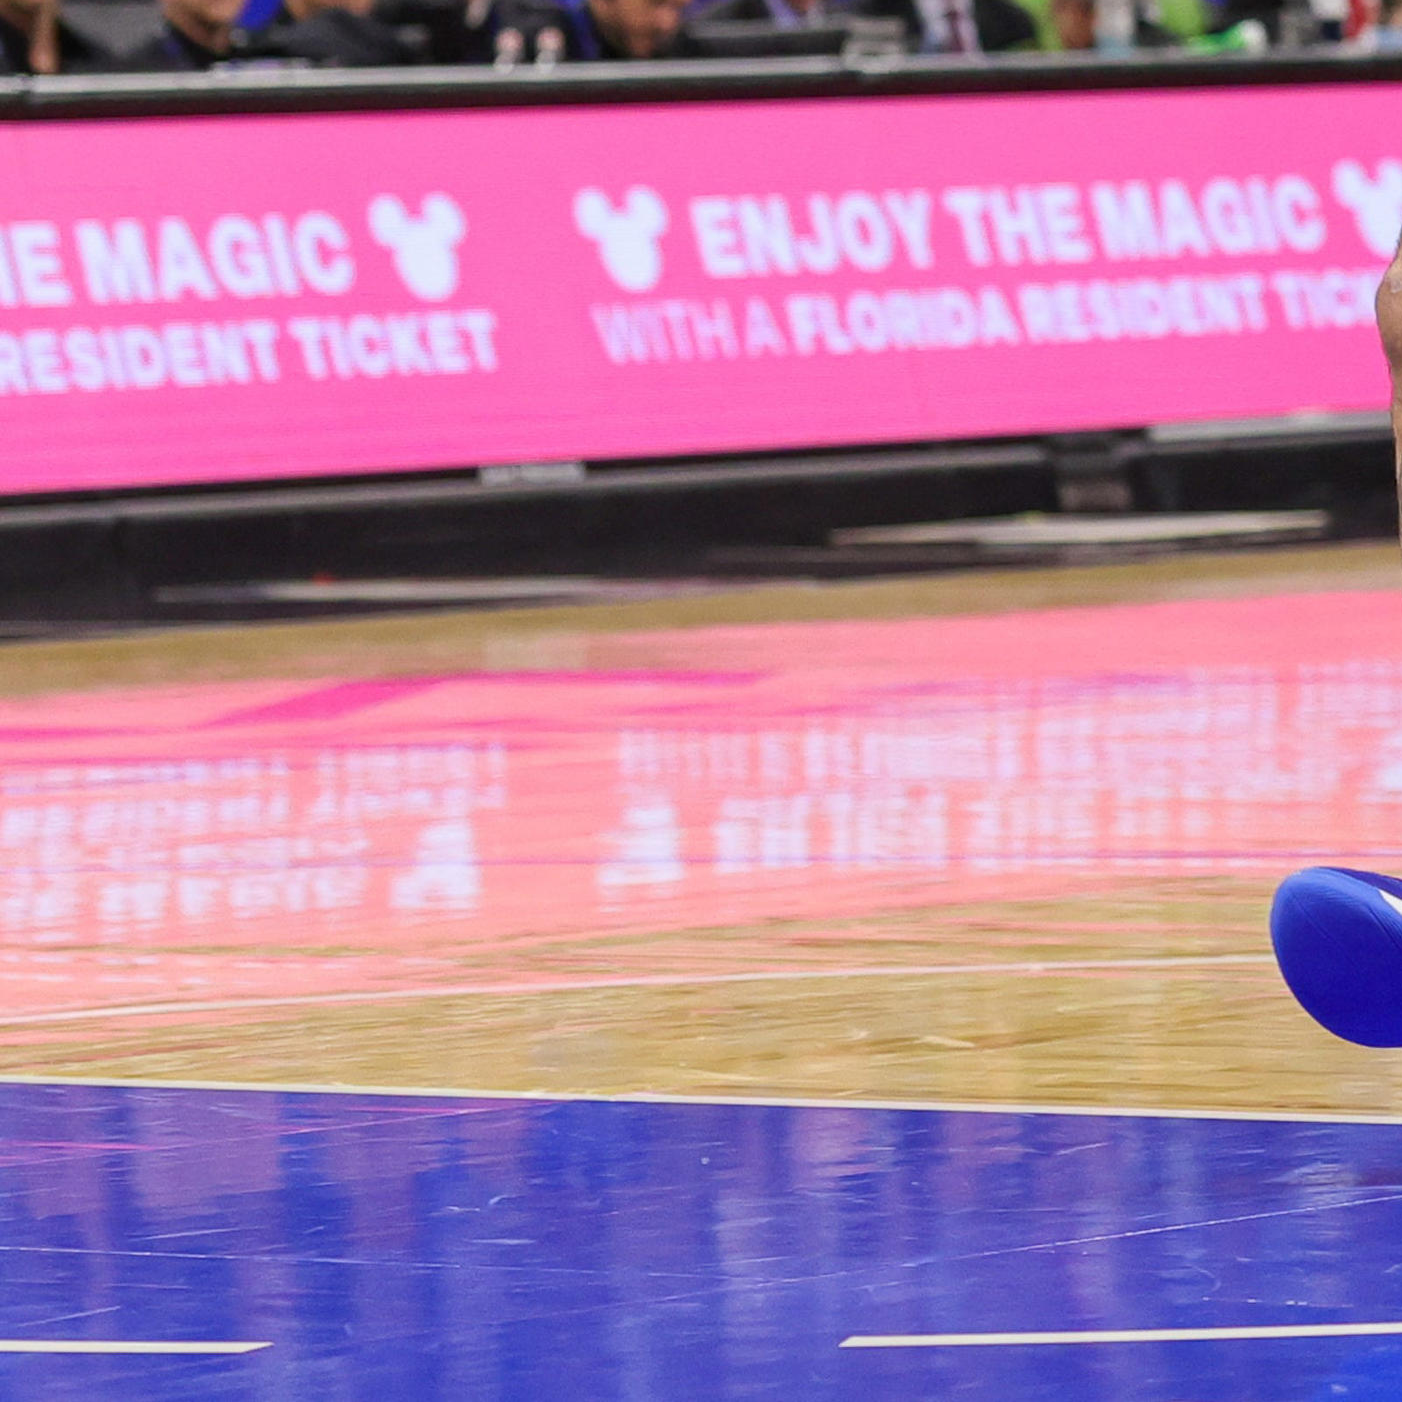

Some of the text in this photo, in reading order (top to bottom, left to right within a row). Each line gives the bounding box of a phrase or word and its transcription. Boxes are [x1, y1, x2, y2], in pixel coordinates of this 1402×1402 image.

[74, 211, 357, 305] MAGIC
[690, 172, 1327, 280] ENJOY THE MAGIC
[290, 307, 499, 382] TICKET
[592, 299, 740, 366] WITH
[743, 298, 787, 360] A
[786, 284, 1017, 356] FLORIDA
[1020, 274, 1269, 346] RESIDENT
